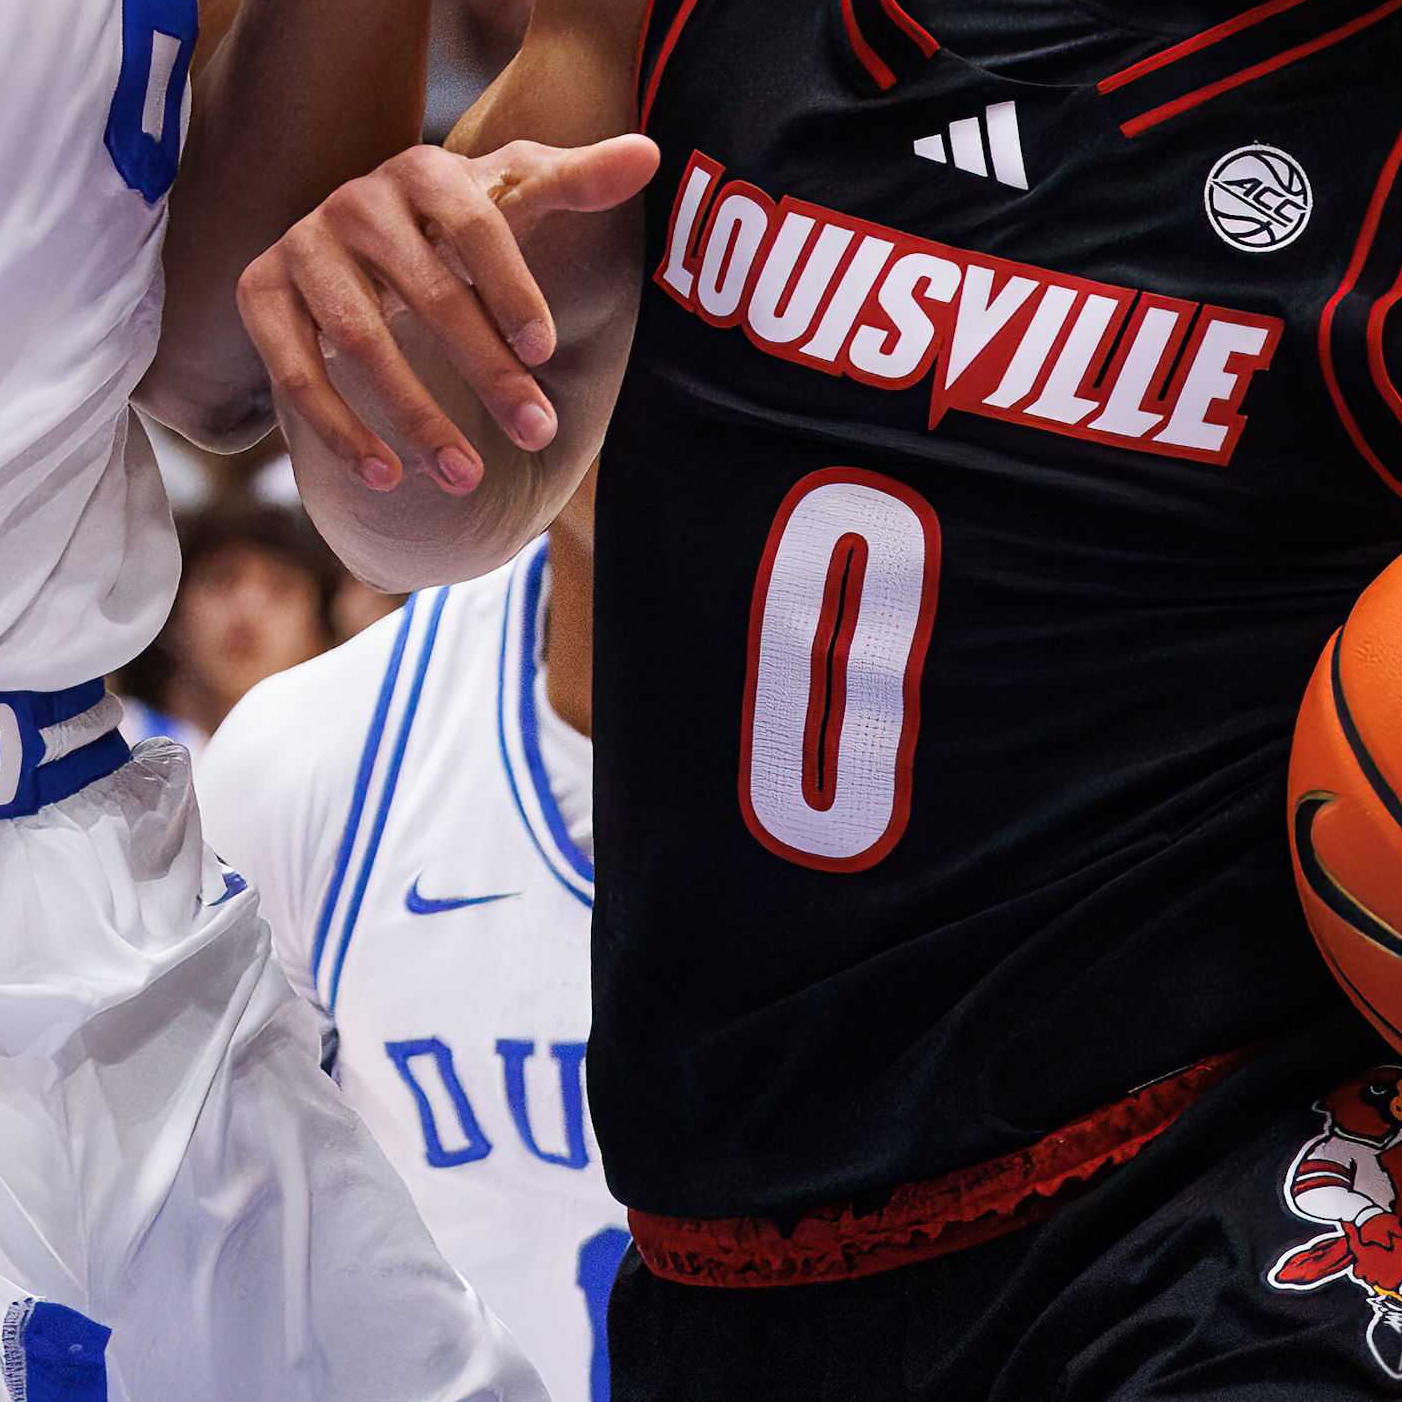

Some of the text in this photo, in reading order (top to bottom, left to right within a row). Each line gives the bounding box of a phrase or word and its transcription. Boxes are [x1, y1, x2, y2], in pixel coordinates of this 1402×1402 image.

[653, 149, 1285, 466] LOUISVILLE
[1221, 177, 1307, 224] ACC
[737, 466, 941, 873] 0
